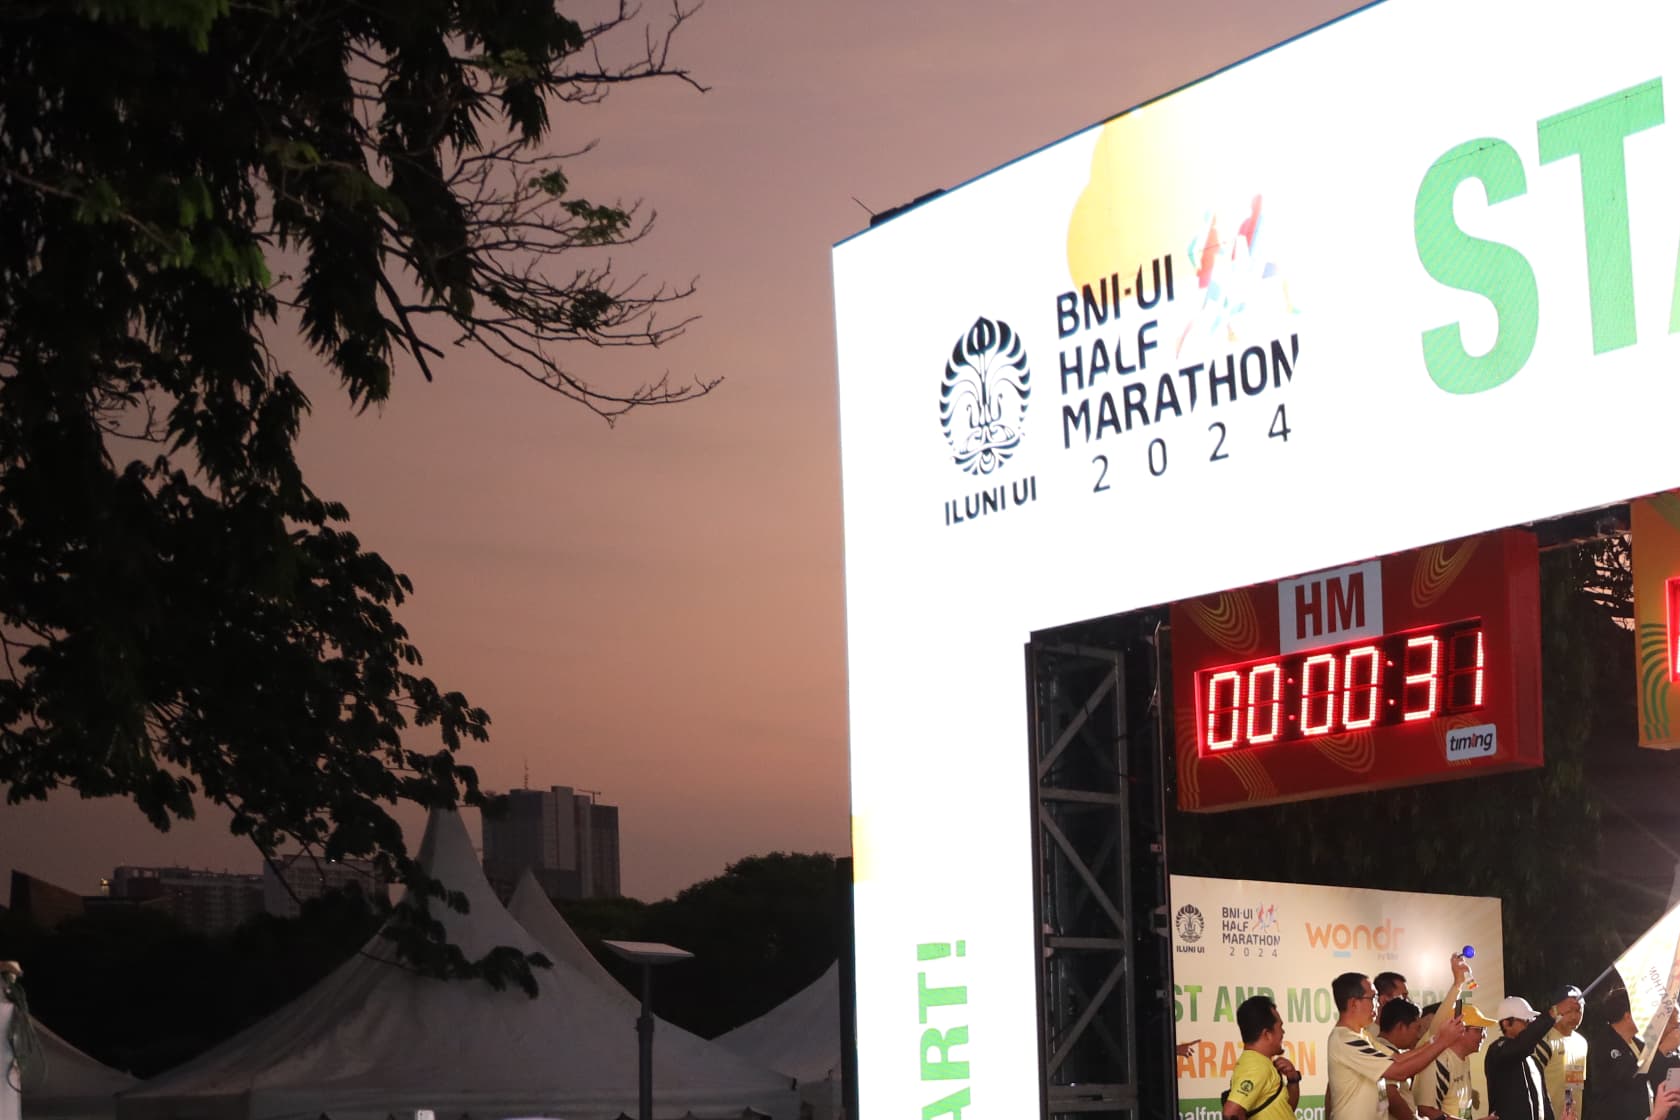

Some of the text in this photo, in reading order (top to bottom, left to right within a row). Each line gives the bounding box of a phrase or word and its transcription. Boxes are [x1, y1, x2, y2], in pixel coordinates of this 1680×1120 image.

[1059, 320, 1159, 395] HALF
[1062, 333, 1299, 449] MARATHON
[944, 475, 1037, 526] ILUNI UI
[1294, 571, 1366, 640] HM
[1207, 631, 1484, 751] 00:00:31
[1449, 729, 1493, 752] timing
[1222, 920, 1249, 932] HALF
[1222, 933, 1280, 946] MARATHON
[1304, 918, 1405, 951] wondr
[1176, 945, 1196, 954] ILUNI
